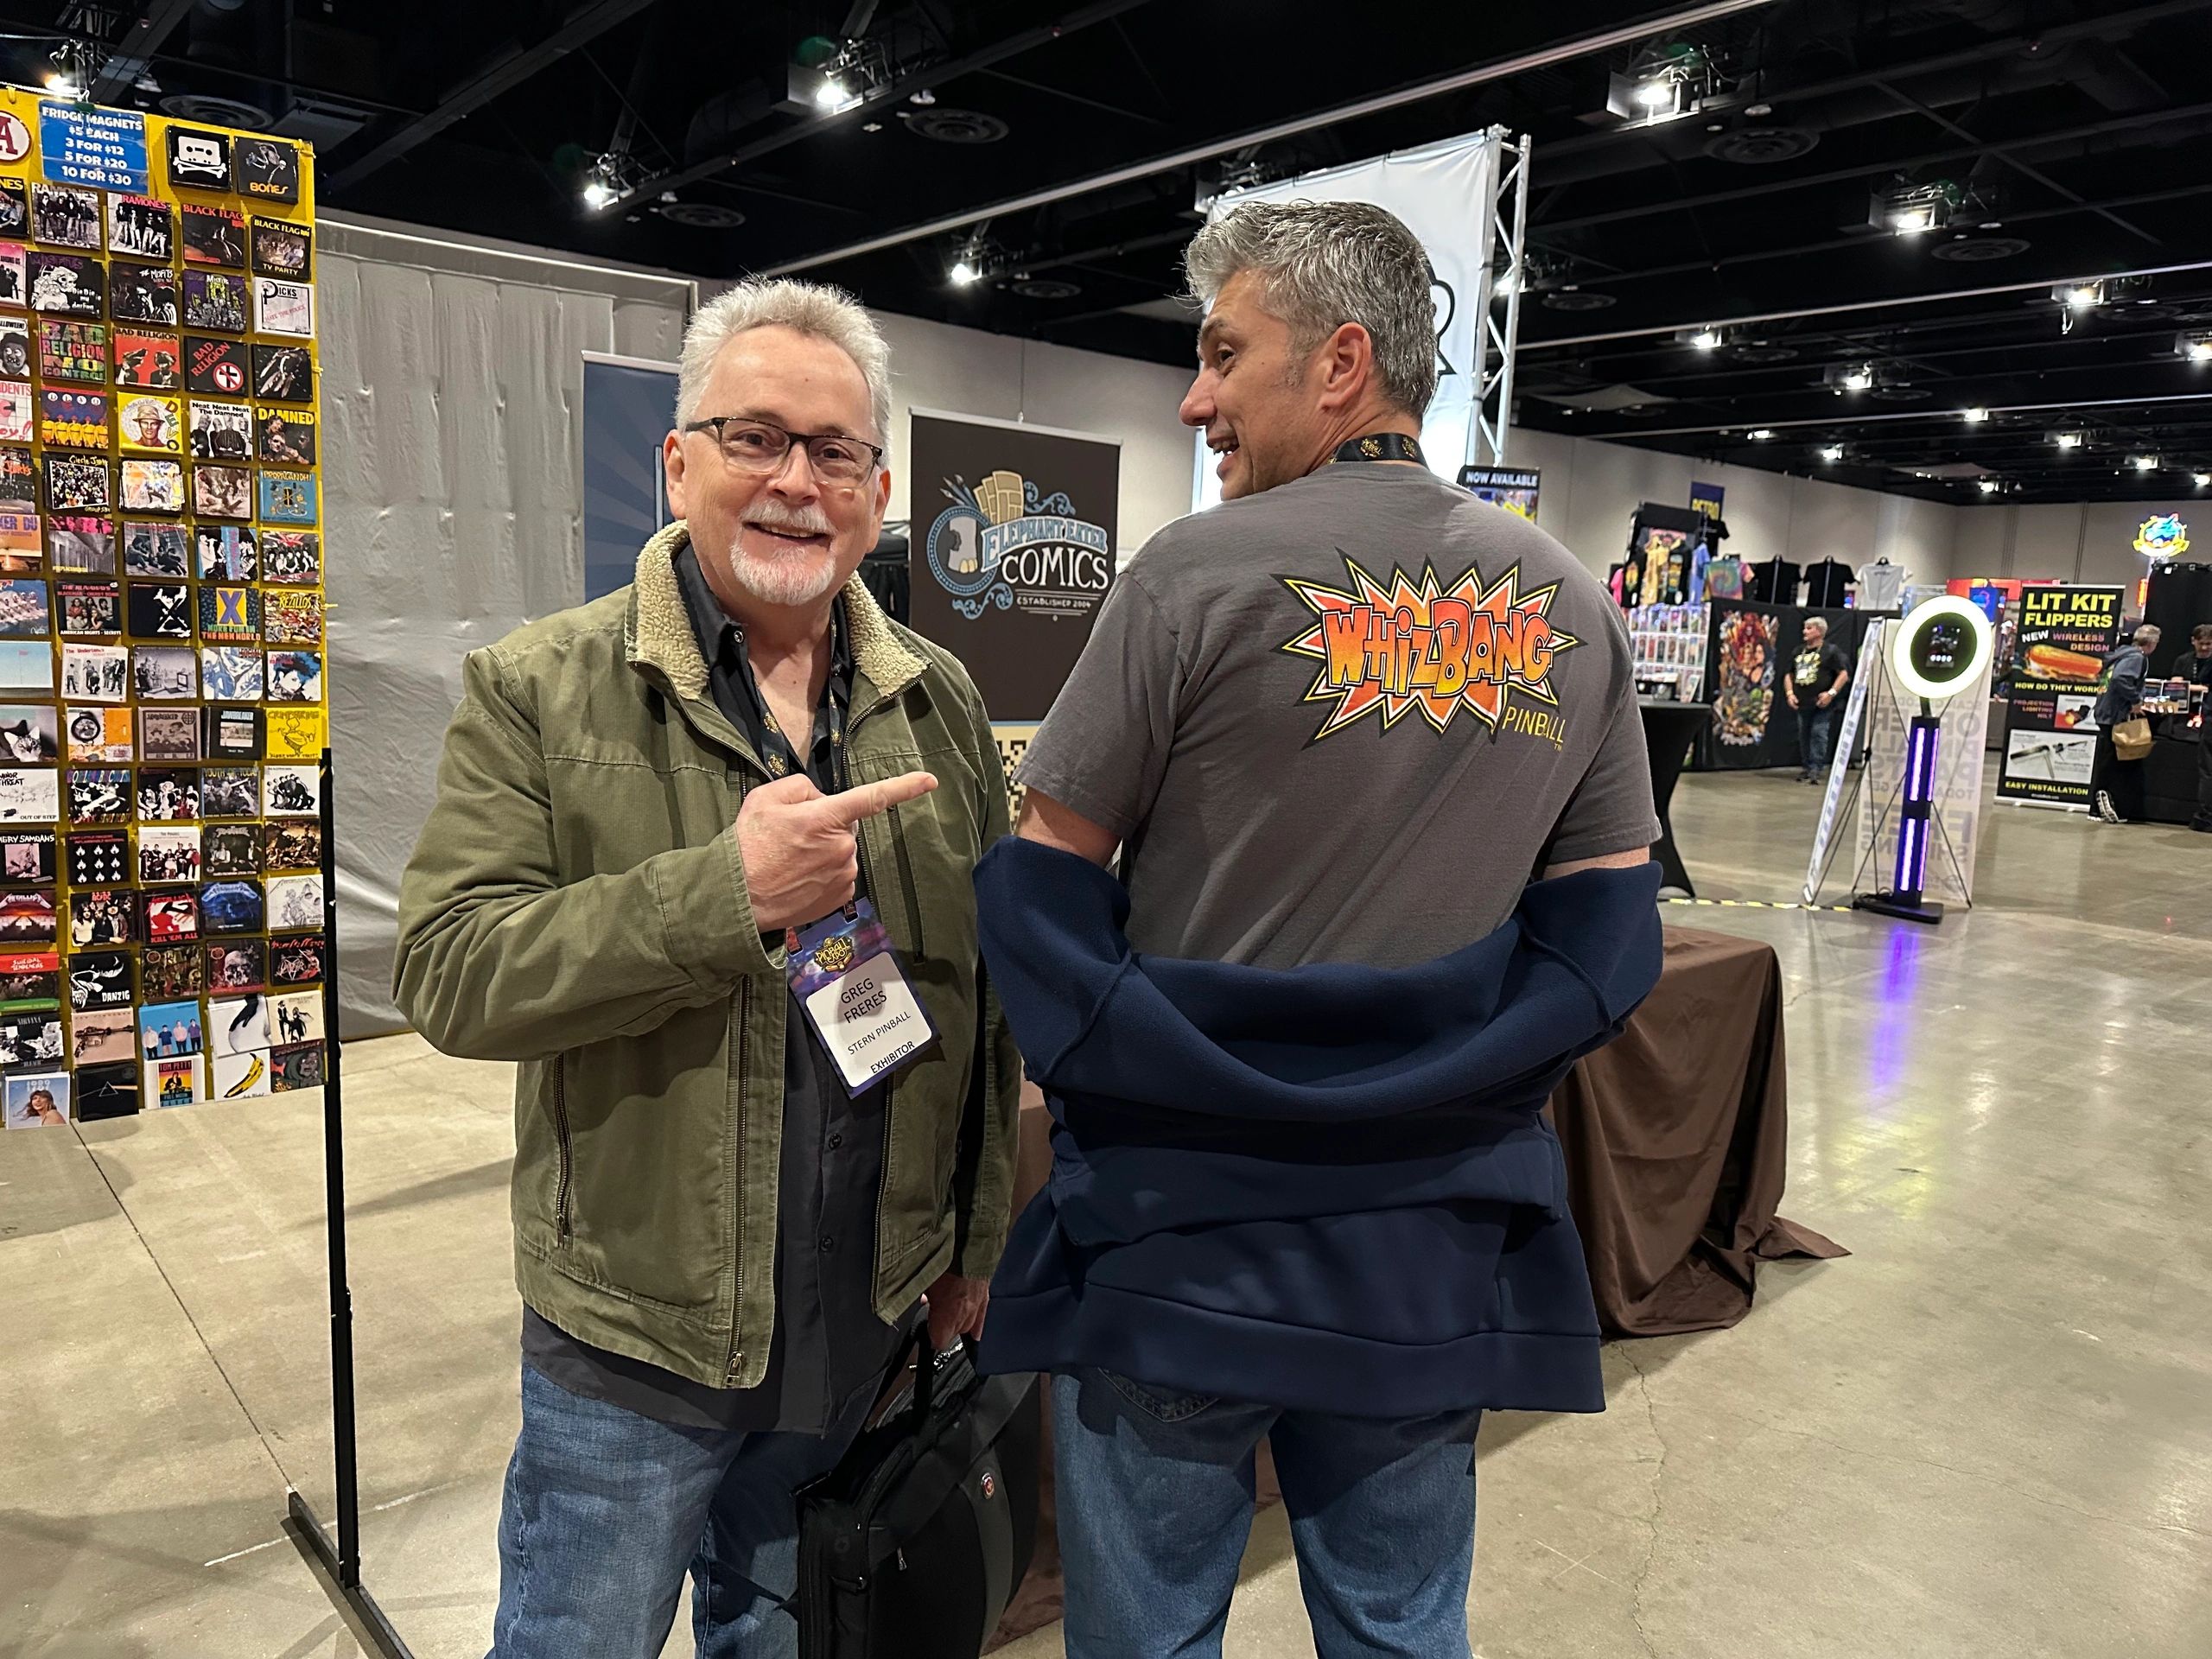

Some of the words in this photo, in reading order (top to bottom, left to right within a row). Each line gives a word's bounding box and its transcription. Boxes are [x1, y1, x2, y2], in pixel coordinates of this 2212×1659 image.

[42, 106, 83, 122] FRIDGE
[88, 114, 143, 130] MAGNETS
[69, 126, 84, 136] $5
[87, 128, 119, 142] EACH
[66, 138, 74, 147] 3
[77, 140, 102, 152] FOR
[105, 145, 124, 156] $12
[65, 151, 74, 161] 5
[76, 153, 101, 166] FOR
[105, 158, 128, 169] $20
[61, 166, 75, 177] 10
[80, 168, 105, 181] FOR
[109, 174, 132, 186] $30
[32, 182, 98, 201] RAMONES
[250, 181, 289, 195] BONES
[122, 194, 168, 208] RAMONES
[183, 204, 215, 216] BLACK
[219, 207, 244, 220] FLAG
[254, 219, 280, 232] BLACK
[281, 225, 301, 235] FLAG
[263, 263, 272, 271] TV
[274, 266, 299, 276] PARTY
[137, 330, 178, 340] RELIGION
[42, 340, 105, 360] RELIGION
[193, 341, 214, 362] BAD
[190, 342, 232, 377] RELIGION
[213, 410, 244, 418] Damned
[257, 407, 315, 425] DAMNED
[1465, 471, 1488, 485] NOW
[1489, 473, 1538, 487] AVAILABLE
[982, 518, 1064, 570] ELEPHANT
[1066, 520, 1108, 553] EATER
[1001, 546, 1109, 589] COMICS
[218, 590, 243, 625] X
[1016, 596, 1071, 608] ESTABLISHED
[2026, 593, 2067, 611] LIT
[2070, 594, 2116, 612] KIT
[2024, 612, 2113, 628] FLIPPERS
[2021, 630, 2049, 644] NEW
[2052, 632, 2106, 643] WIRELESS
[2070, 642, 2110, 652] DESIGN
[2050, 683, 2073, 692] THEY
[1501, 706, 1567, 743] PINBALL
[2005, 781, 2027, 791] EASY
[2028, 782, 2089, 796] INSTALLATION
[150, 935, 167, 944] KILL
[102, 989, 130, 1002] DANZIG
[841, 977, 874, 1005] GREG
[843, 990, 887, 1024] FRERES
[17, 1016, 41, 1026] NIRVANA
[848, 1032, 876, 1056] STERN
[875, 1010, 912, 1037] PINBALL
[870, 1039, 916, 1074] EXHIBITOR
[159, 1062, 172, 1071] TOM
